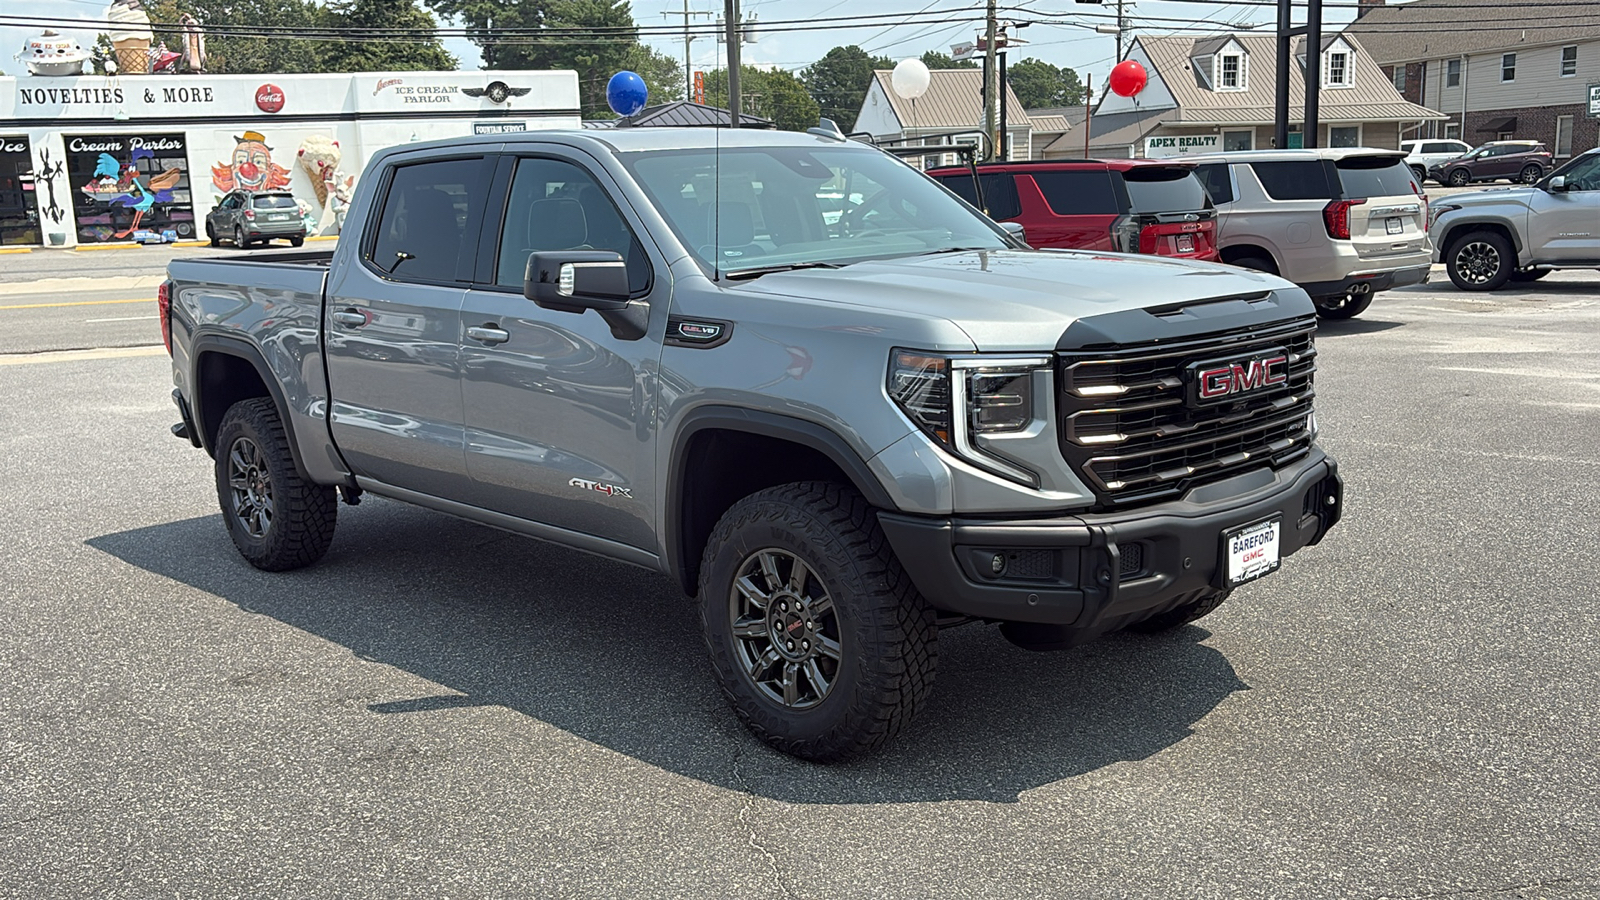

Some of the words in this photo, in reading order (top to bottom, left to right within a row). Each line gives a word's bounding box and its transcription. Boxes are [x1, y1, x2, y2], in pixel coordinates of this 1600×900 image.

[20, 89, 124, 105] NOVELTIES
[143, 88, 155, 104] &
[162, 87, 214, 103] MORE
[396, 87, 414, 95] ICE
[417, 86, 459, 94] CREAM
[404, 95, 451, 104] PARLOR
[69, 138, 122, 152] Cream
[129, 137, 182, 151] Parlor
[1149, 138, 1176, 147] APEX
[1179, 136, 1217, 146] REALTY
[1198, 355, 1287, 399] GMC
[568, 477, 633, 499] AT4X
[1233, 530, 1274, 555] BAREFORD
[1242, 548, 1264, 563] GMC
